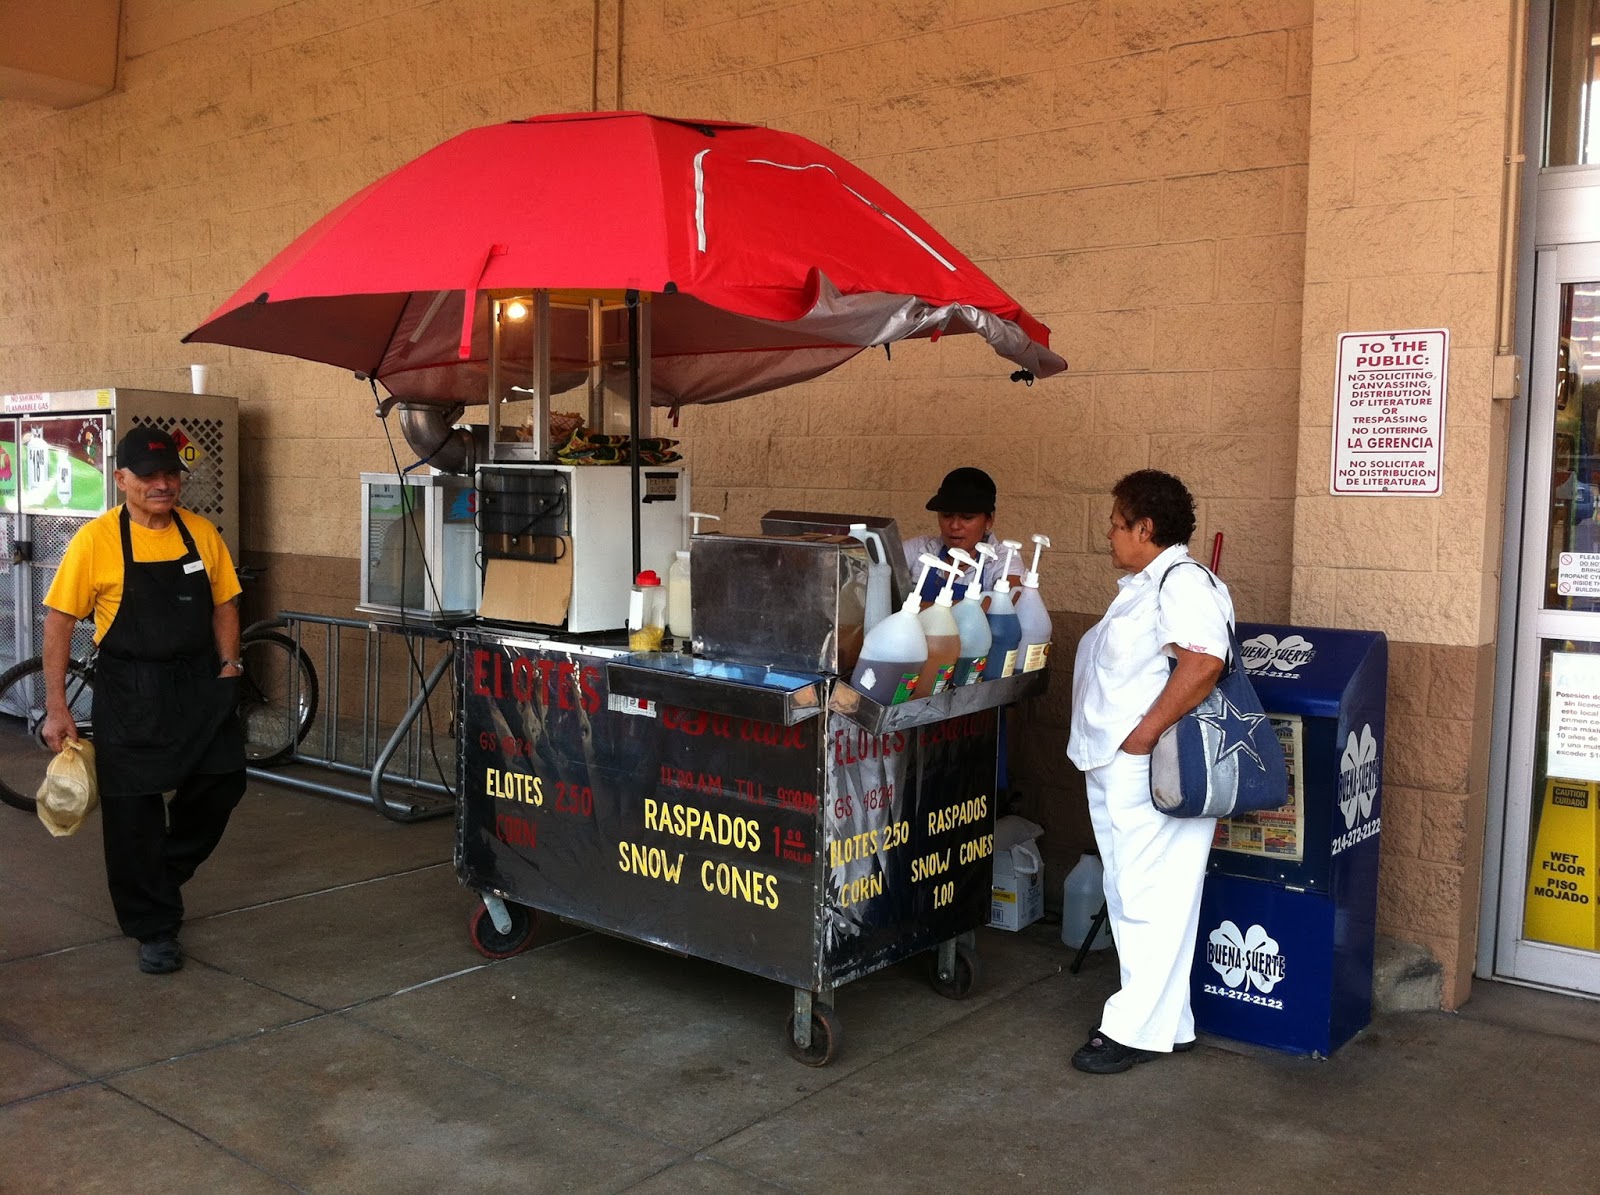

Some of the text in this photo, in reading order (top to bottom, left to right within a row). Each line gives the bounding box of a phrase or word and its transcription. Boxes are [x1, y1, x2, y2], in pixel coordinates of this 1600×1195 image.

[1359, 341, 1428, 354] TO THE
[1356, 355, 1430, 367] PUBLIC:
[1369, 372, 1437, 381] SOLICITING,
[1352, 381, 1431, 390] CANVASSING,
[10, 394, 43, 403] NO SMOKING
[1352, 390, 1431, 398] DISTRIBUTION
[1367, 398, 1432, 406] LITERATURE
[5, 402, 49, 412] FLAMMABLE GAS
[1353, 416, 1427, 424] TRESPASSING
[1347, 437, 1433, 449] LA GERENCIA
[1359, 469, 1436, 477] DISTRIBUCION
[1346, 478, 1426, 486] DE LITERATURA
[473, 649, 601, 715] ELOTES
[479, 731, 497, 751] GS
[834, 728, 905, 766] ELOTES
[1556, 749, 1587, 757] exceder
[486, 767, 544, 807] ELOTES
[735, 779, 766, 806] TILL
[1555, 788, 1586, 799] CAUTION
[834, 784, 893, 819] GS 4824
[1554, 796, 1586, 808] CUIDADO
[928, 795, 987, 837] RASPADOS
[495, 812, 538, 849] CORN
[644, 798, 761, 853] RASPADOS
[1331, 817, 1381, 856] 214-272-2122
[830, 829, 878, 869] ELOTES
[911, 833, 993, 883] SNOW CONES
[1550, 851, 1579, 865] WET
[618, 841, 779, 910] SNOW CONES
[1542, 861, 1586, 877] FLOOR
[841, 871, 883, 908] CORN
[1547, 878, 1578, 892] PISO
[933, 881, 954, 910] 1.00
[1534, 886, 1589, 905] MOJADO
[1204, 984, 1284, 1010] 214-272-2122
